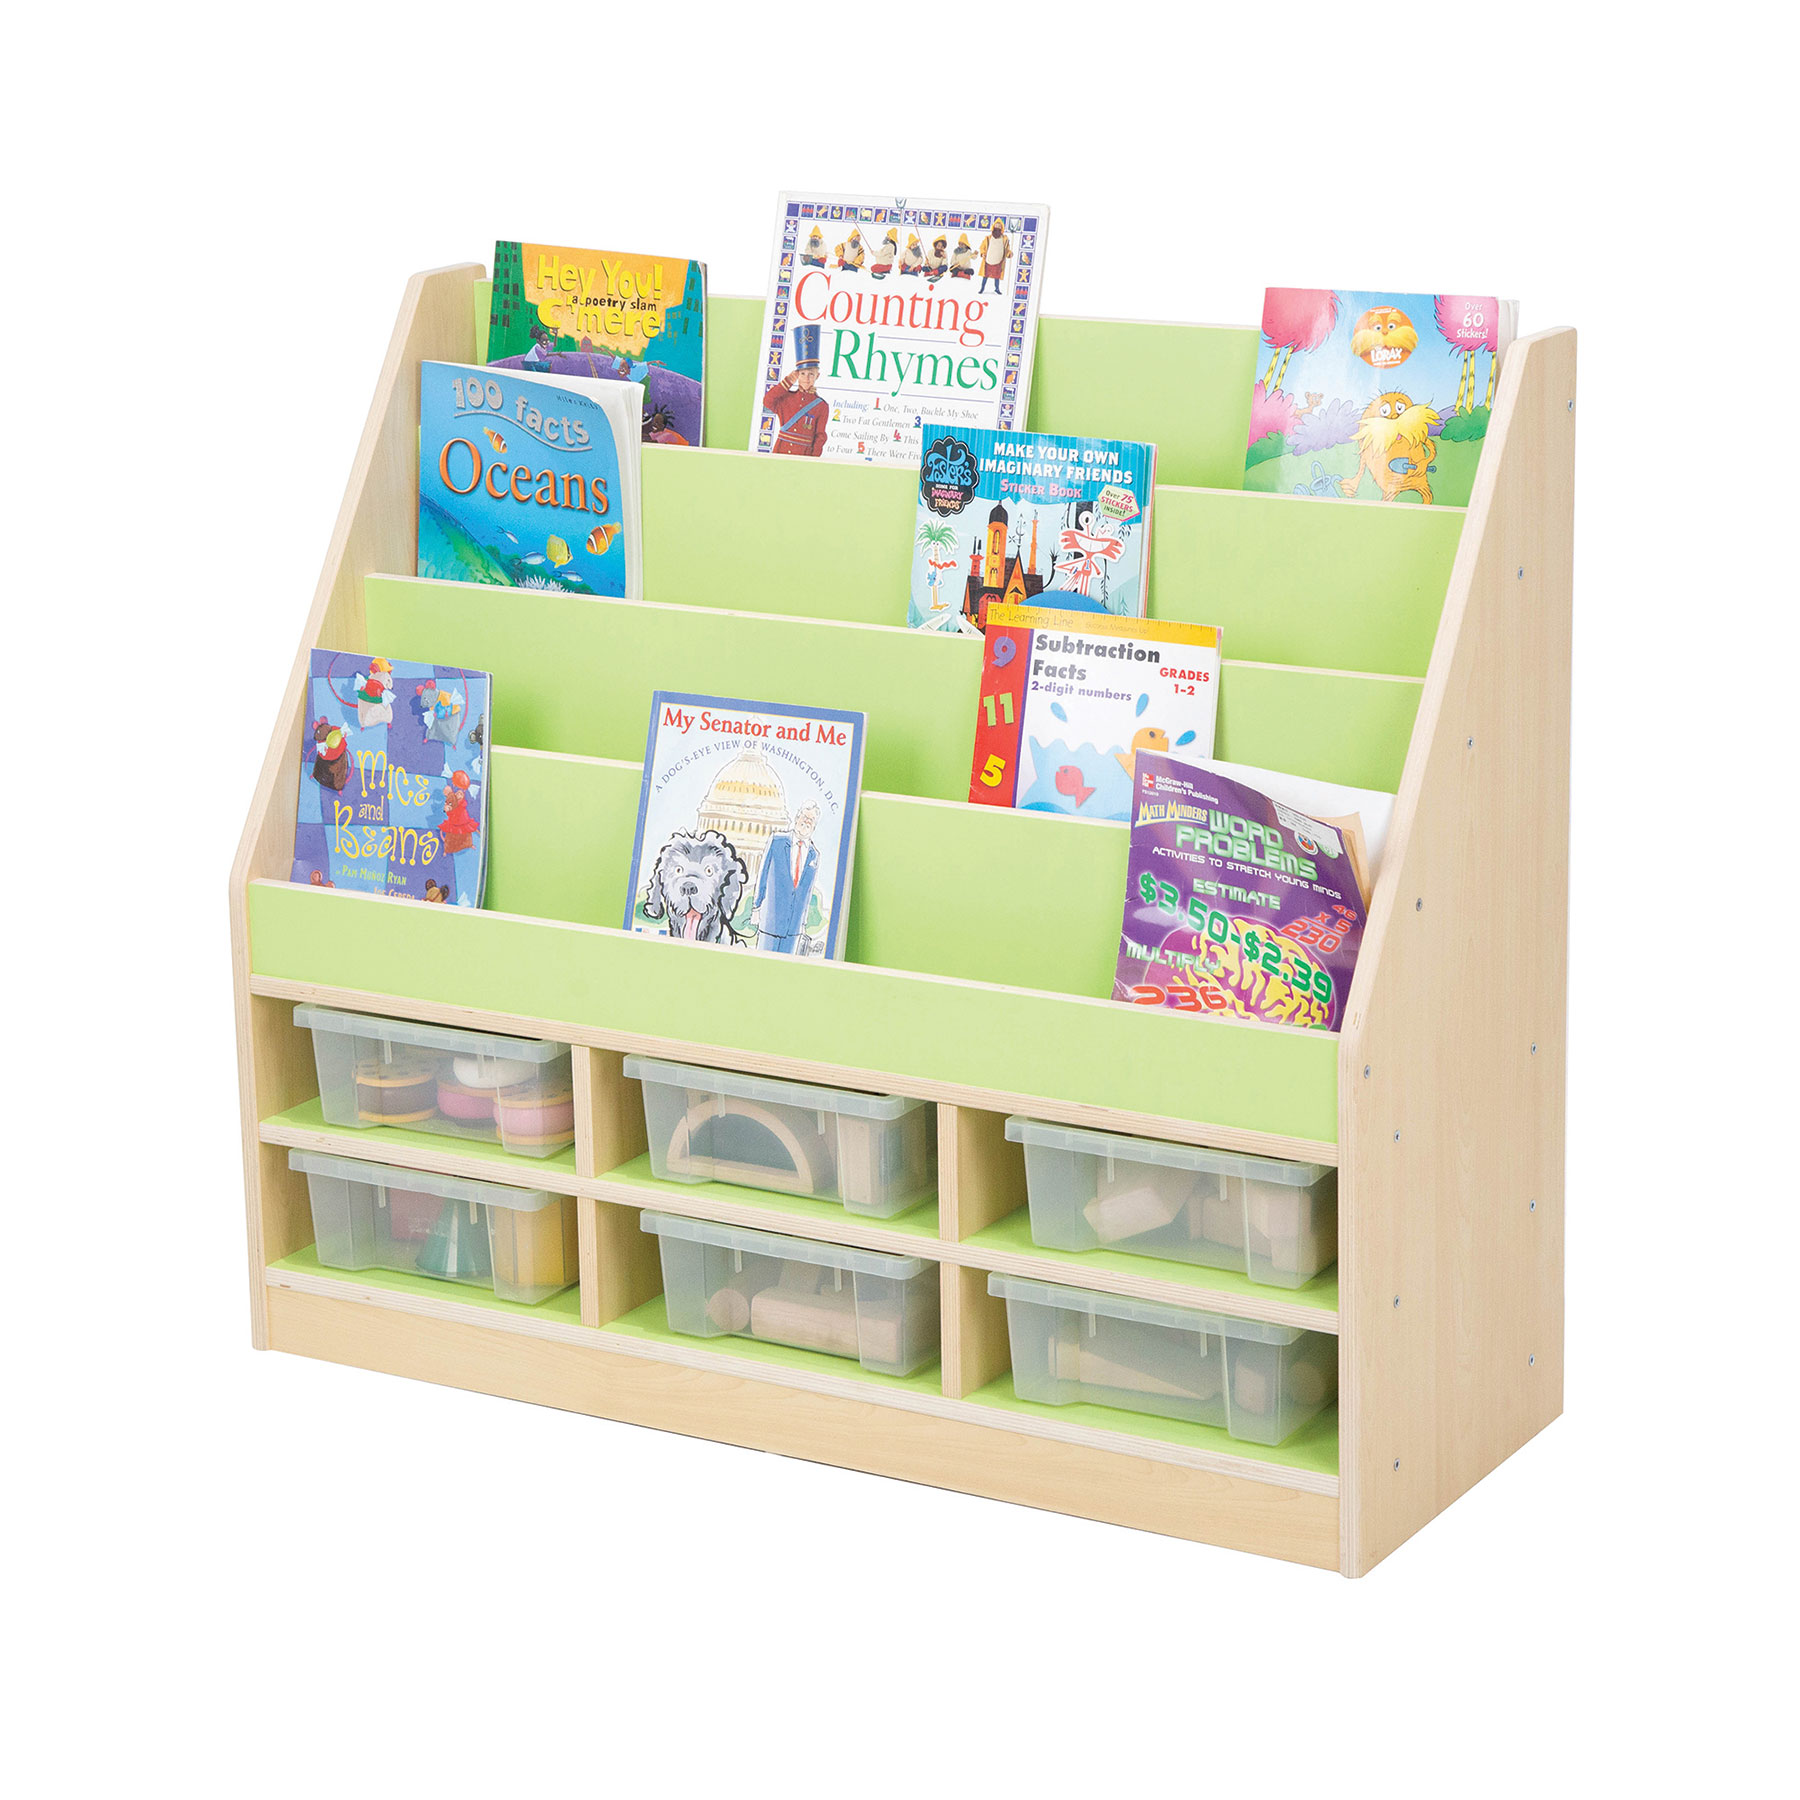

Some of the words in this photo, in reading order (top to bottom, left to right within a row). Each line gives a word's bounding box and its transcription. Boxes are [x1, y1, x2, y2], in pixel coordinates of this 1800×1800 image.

[537, 254, 596, 305] Hey
[602, 259, 663, 300] You!
[572, 296, 578, 304] a
[586, 298, 626, 311] poetry
[630, 298, 657, 311] slam
[794, 271, 989, 347] Counting
[1465, 302, 1482, 310] Over
[537, 296, 660, 338] C'mere
[1463, 312, 1483, 328] 60
[1456, 328, 1488, 339] Stickers!
[828, 329, 999, 397] Rhymes
[1371, 347, 1402, 362] LORAX
[452, 377, 503, 409] 100
[516, 396, 591, 445] facts
[832, 409, 840, 421] 2
[843, 415, 857, 423] Two
[858, 415, 870, 425] Fat
[872, 417, 910, 429] Gentlemen
[913, 416, 922, 428] 3
[921, 407, 945, 417] Buckle
[949, 409, 959, 419] My
[961, 411, 979, 419] Shoe
[831, 430, 851, 439] Come
[853, 431, 878, 442] Sailing
[880, 433, 889, 442] By
[893, 429, 902, 442] 4
[904, 435, 919, 445] This
[836, 446, 853, 454] Four
[857, 442, 864, 454] 5
[868, 447, 887, 457] There
[890, 450, 906, 458] Were
[994, 442, 1034, 459] MAKE
[1038, 446, 1080, 463] YOUR
[1084, 450, 1119, 466] OWN
[439, 438, 609, 515] Oceans
[980, 458, 1064, 479] IMAGINARY
[1066, 465, 1133, 484] FRIENDS
[1000, 478, 1045, 496] STICKER
[1049, 483, 1082, 498] BOOK
[1106, 490, 1120, 499] Over
[1121, 494, 1133, 503] 75
[1101, 496, 1133, 512] STICKERS
[1104, 505, 1126, 516] INSIDE!
[990, 609, 1005, 621] The
[1009, 611, 1049, 628] Learning
[1054, 615, 1074, 628] Line
[992, 636, 1016, 667] 9
[1035, 633, 1160, 664] Subtraction
[1033, 660, 1087, 681] Facts
[1160, 667, 1210, 682] GRADES
[1031, 681, 1075, 696] 2-digit
[1078, 688, 1132, 702] numbers
[1174, 684, 1196, 696] 1-2
[983, 692, 1014, 727] 11
[663, 707, 695, 734] My
[700, 711, 772, 738] Senator
[776, 722, 810, 741] and
[815, 724, 847, 746] Me
[656, 783, 663, 793] A
[661, 745, 711, 784] DOG'S-EYE
[713, 739, 742, 752] VIEW
[743, 739, 758, 750] OF
[761, 743, 824, 791] WASHINGTON,
[824, 791, 839, 815] D.C.
[979, 754, 1006, 787] 5
[1156, 775, 1194, 789] McGraw-Hill
[1156, 783, 1186, 795] Children's
[1188, 789, 1218, 805] Publishing
[358, 796, 384, 821] and
[1139, 801, 1165, 820] MATH
[1167, 800, 1207, 822] MINDERS
[1208, 810, 1283, 850] WORD
[1176, 824, 1318, 881] PROBLEMS
[1152, 846, 1205, 864] ACTIVITIES
[1209, 857, 1223, 868] TO
[1227, 861, 1272, 879] STRETCH
[1274, 874, 1309, 890] YOUNG
[1313, 883, 1341, 900] MINDS
[1193, 878, 1280, 911] ESTIMATE
[1332, 905, 1357, 920] 46
[1281, 920, 1341, 953] 230
[1335, 919, 1352, 934] 5
[1126, 942, 1221, 974] MULTIPLY
[1132, 986, 1227, 1012] 236
